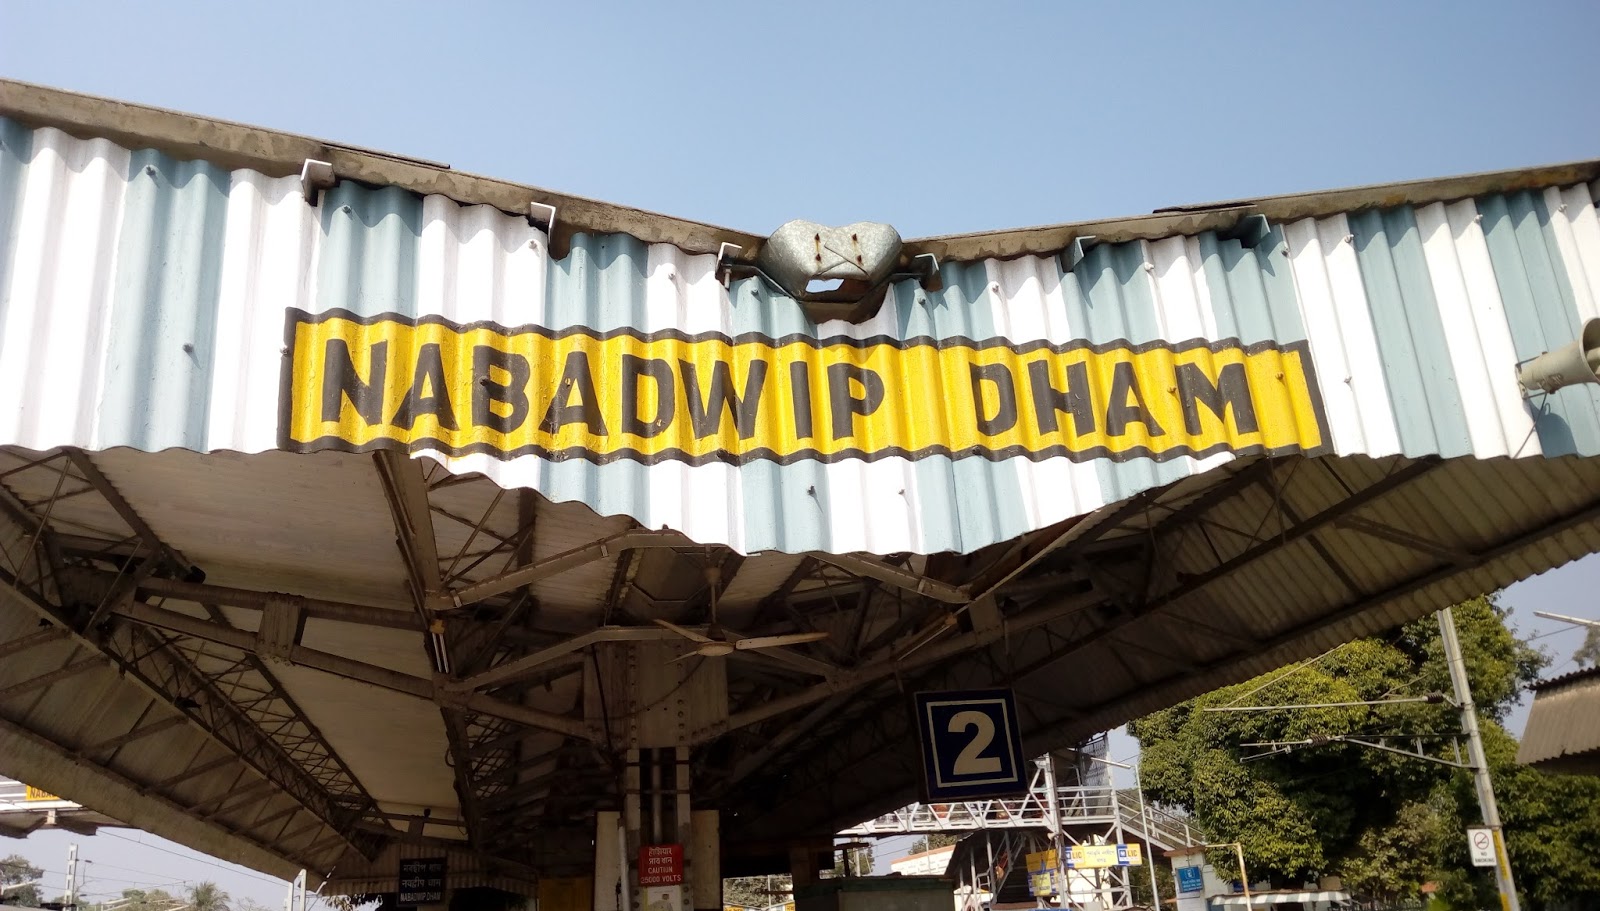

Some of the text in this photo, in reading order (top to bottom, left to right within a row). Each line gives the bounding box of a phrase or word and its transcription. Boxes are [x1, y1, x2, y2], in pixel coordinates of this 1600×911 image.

[320, 338, 1261, 442] NABADWIP DHAM
[947, 710, 1003, 776] 2
[648, 866, 673, 874] CAUTION
[640, 874, 682, 884] 25000 VOLTS
[427, 892, 441, 901] DHAM
